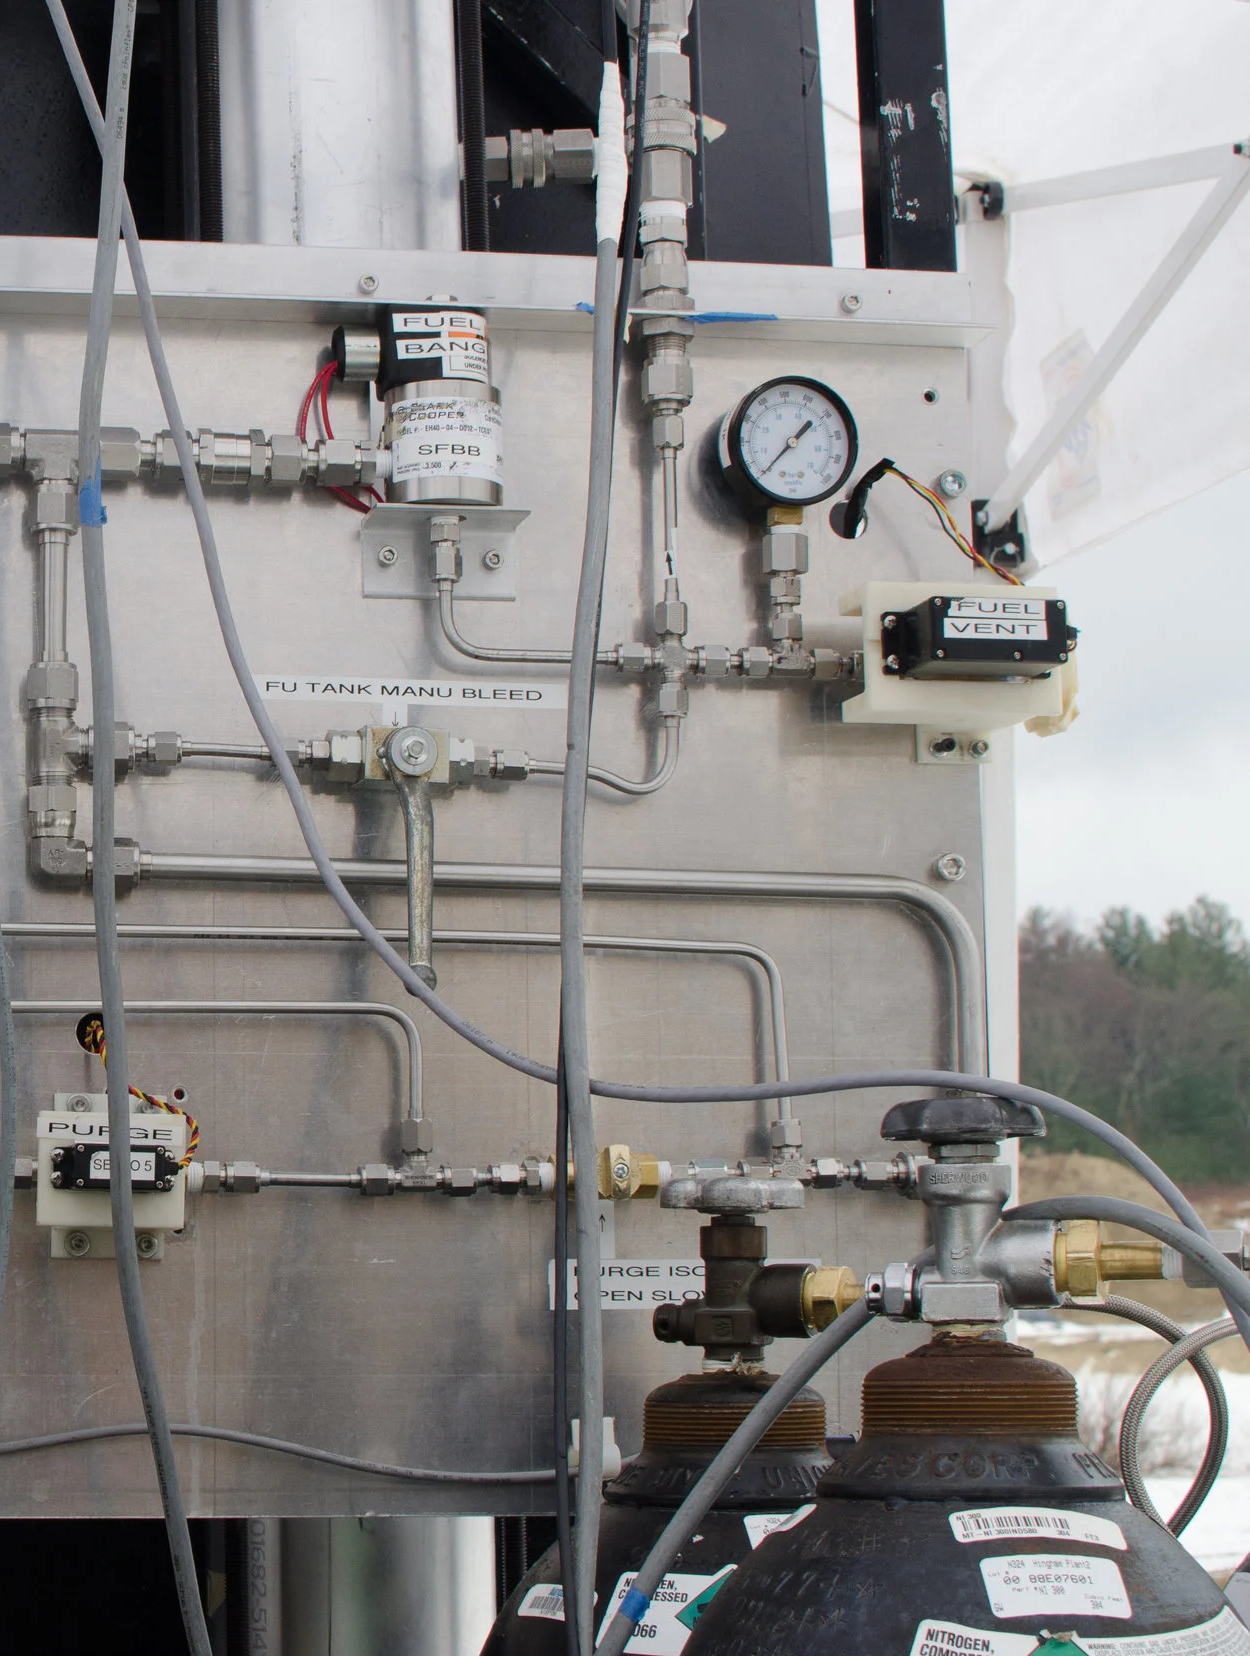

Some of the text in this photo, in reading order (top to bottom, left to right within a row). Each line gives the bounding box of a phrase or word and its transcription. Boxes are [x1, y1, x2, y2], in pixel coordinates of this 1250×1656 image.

[402, 316, 482, 331] FUEL
[404, 340, 486, 355] BANG
[417, 444, 482, 458] SFBB
[957, 601, 1041, 615] FUEL
[950, 622, 1038, 635] VENT
[265, 681, 543, 701] FU TANK MANU BLEED
[93, 1158, 153, 1172] SEO 5
[929, 1171, 988, 1185] SHERWOOD
[574, 1266, 661, 1278] RGE
[574, 1290, 707, 1302] PEN SLO
[1028, 1573, 1094, 1585] 88E07601
[618, 1589, 688, 1603] CESSED
[925, 1628, 996, 1654] NITROGEN,
